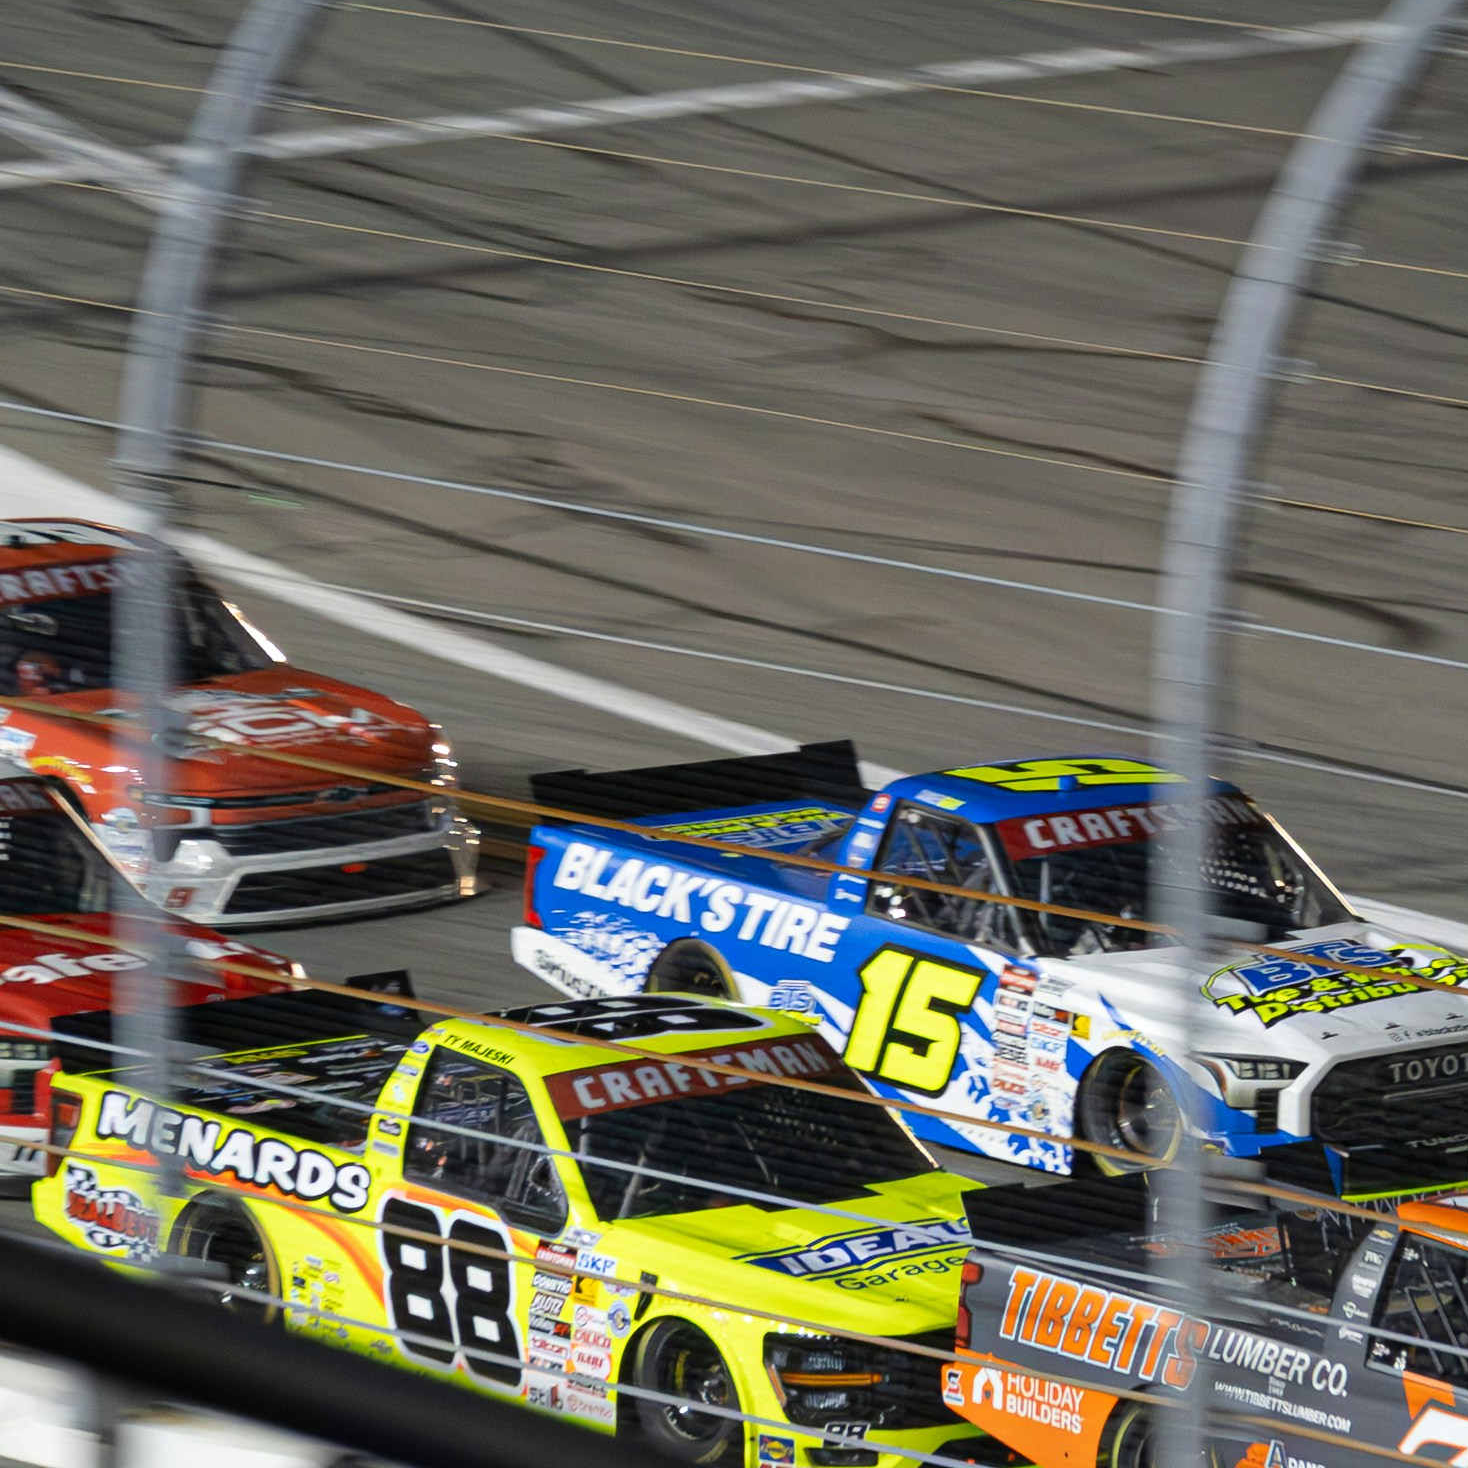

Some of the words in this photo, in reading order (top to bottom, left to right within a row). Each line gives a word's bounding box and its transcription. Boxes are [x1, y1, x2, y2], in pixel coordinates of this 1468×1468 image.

[553, 842, 744, 934] BLACK'S
[738, 892, 850, 963] TIRE
[443, 1034, 459, 1045] TY
[460, 1040, 517, 1065] MAJESKI
[843, 947, 984, 1093] 15
[573, 1041, 834, 1110] CRAFTSMAN
[98, 1090, 371, 1213] MENARDS
[379, 1195, 524, 1389] 88
[834, 1256, 965, 1291] Garage
[999, 1266, 1211, 1392] TIBBETTS
[1208, 1329, 1311, 1386] LUMBER
[1312, 1359, 1348, 1398] CO.
[1006, 1393, 1084, 1435] BUILDERS
[1007, 1371, 1085, 1413] HOLIDAY
